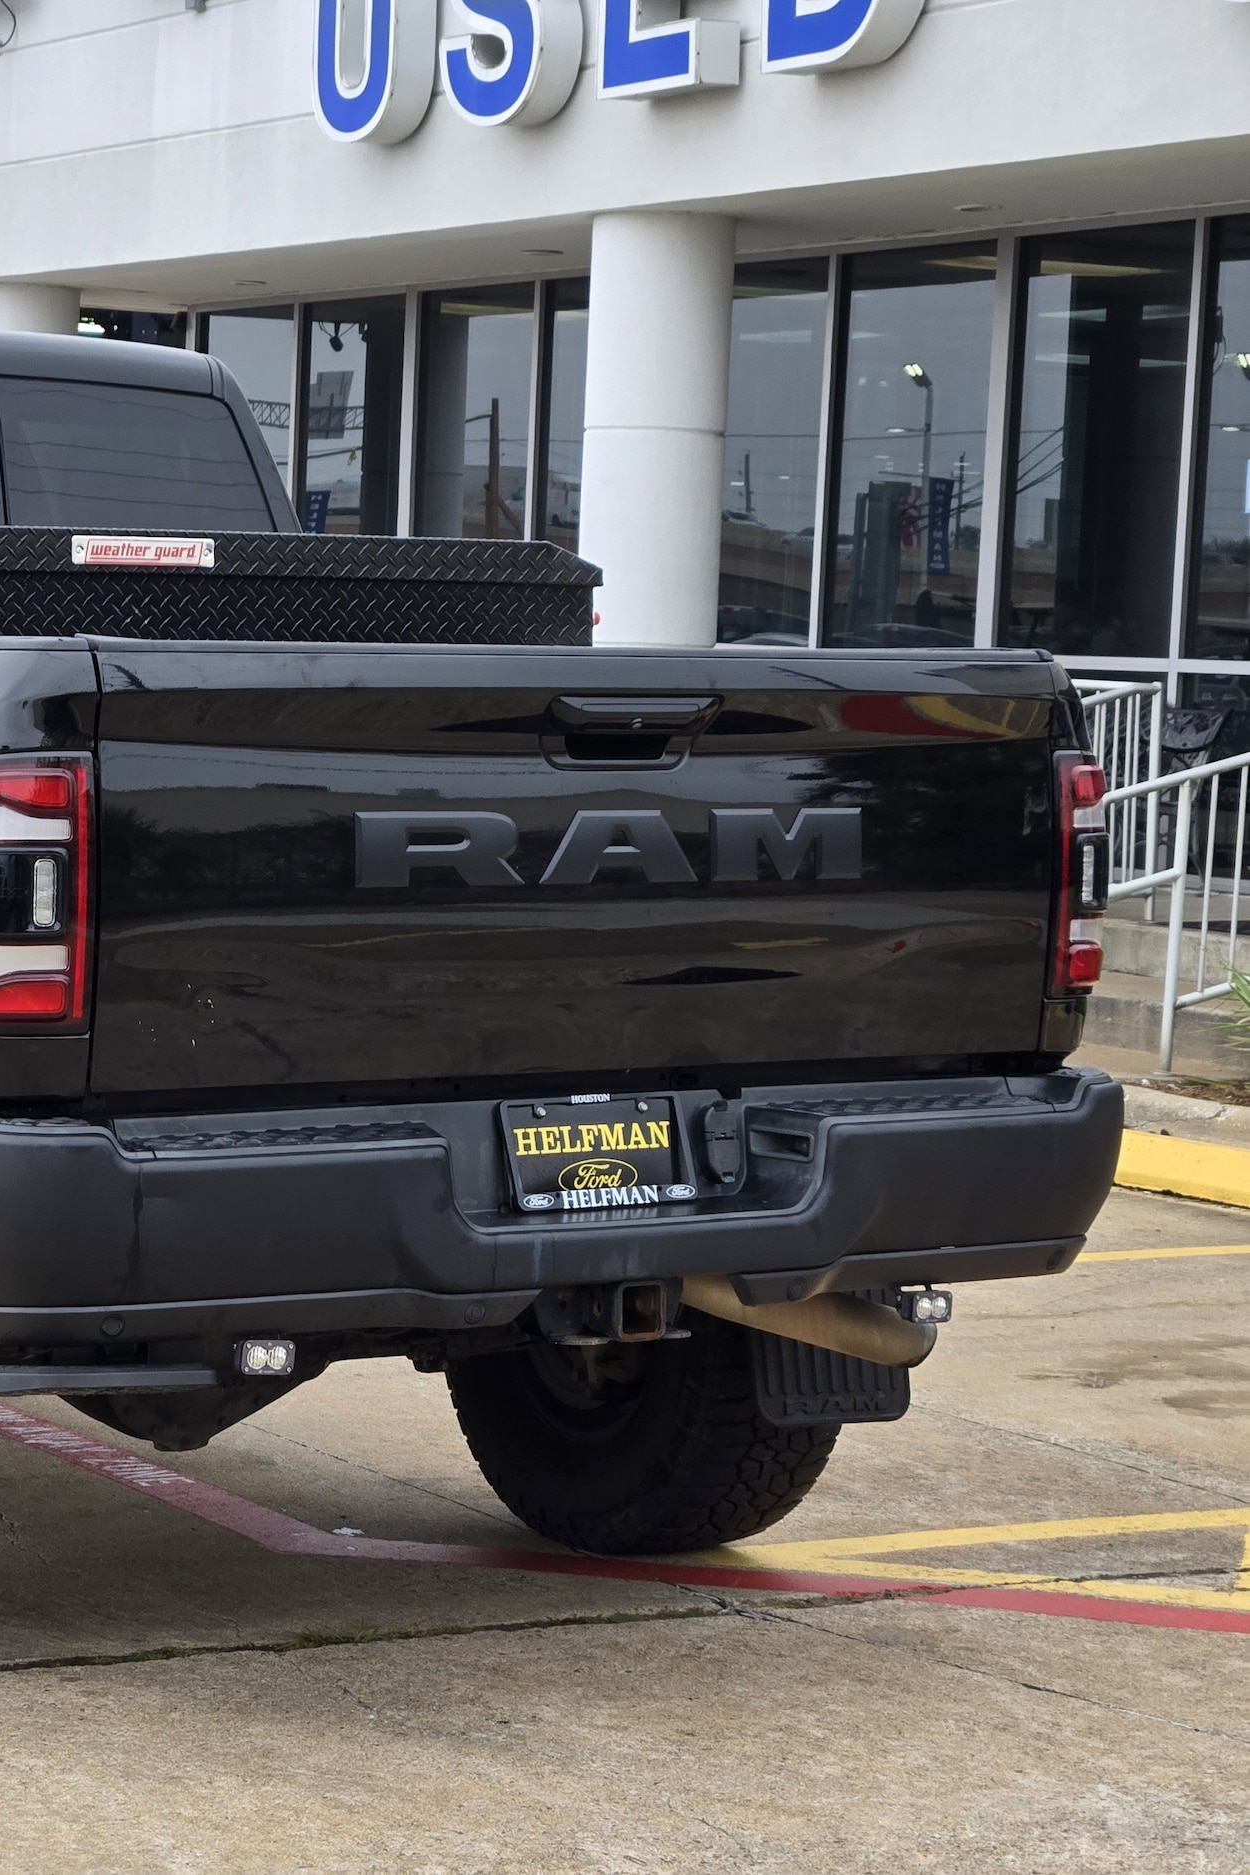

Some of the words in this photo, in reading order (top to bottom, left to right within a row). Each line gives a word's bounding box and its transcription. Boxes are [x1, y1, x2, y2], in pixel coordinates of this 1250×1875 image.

[90, 543, 151, 557] weather
[154, 544, 196, 560] guard
[354, 807, 862, 888] RAM
[570, 1093, 611, 1104] HOUSTON
[513, 1120, 670, 1155] HELFMAN
[573, 1162, 623, 1189] Ford
[525, 1195, 551, 1207] Ford
[561, 1185, 659, 1209] HELFMAN
[668, 1186, 693, 1197] Ford
[781, 1395, 887, 1415] RAM
